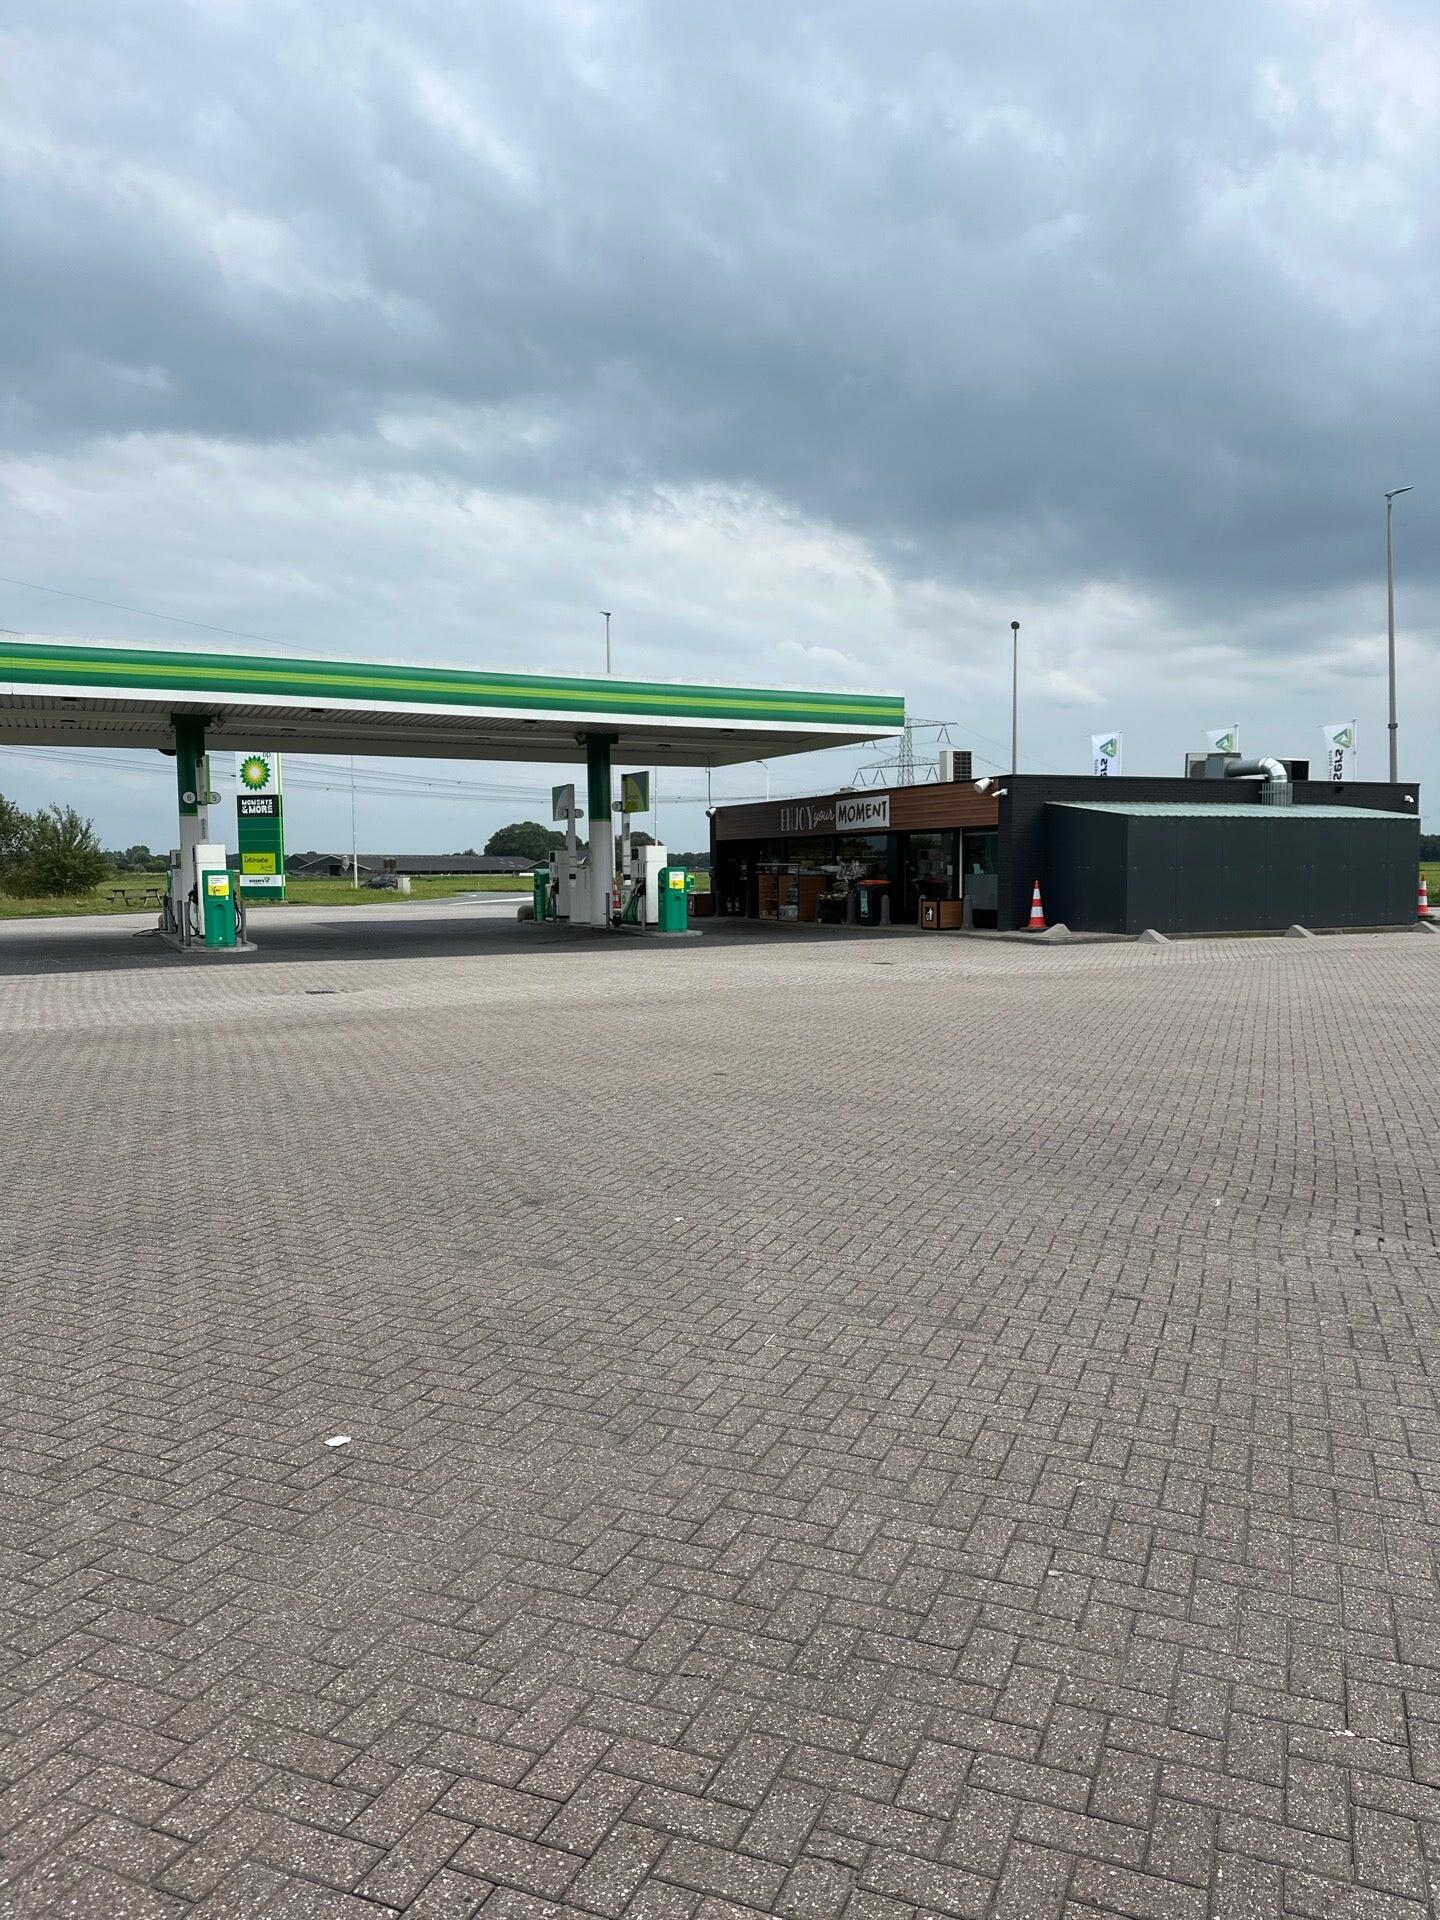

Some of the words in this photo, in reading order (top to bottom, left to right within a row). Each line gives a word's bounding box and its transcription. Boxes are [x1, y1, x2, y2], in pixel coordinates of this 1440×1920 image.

[781, 805, 815, 832] ENJOY
[813, 809, 836, 828] your
[838, 801, 887, 824] MOMENT
